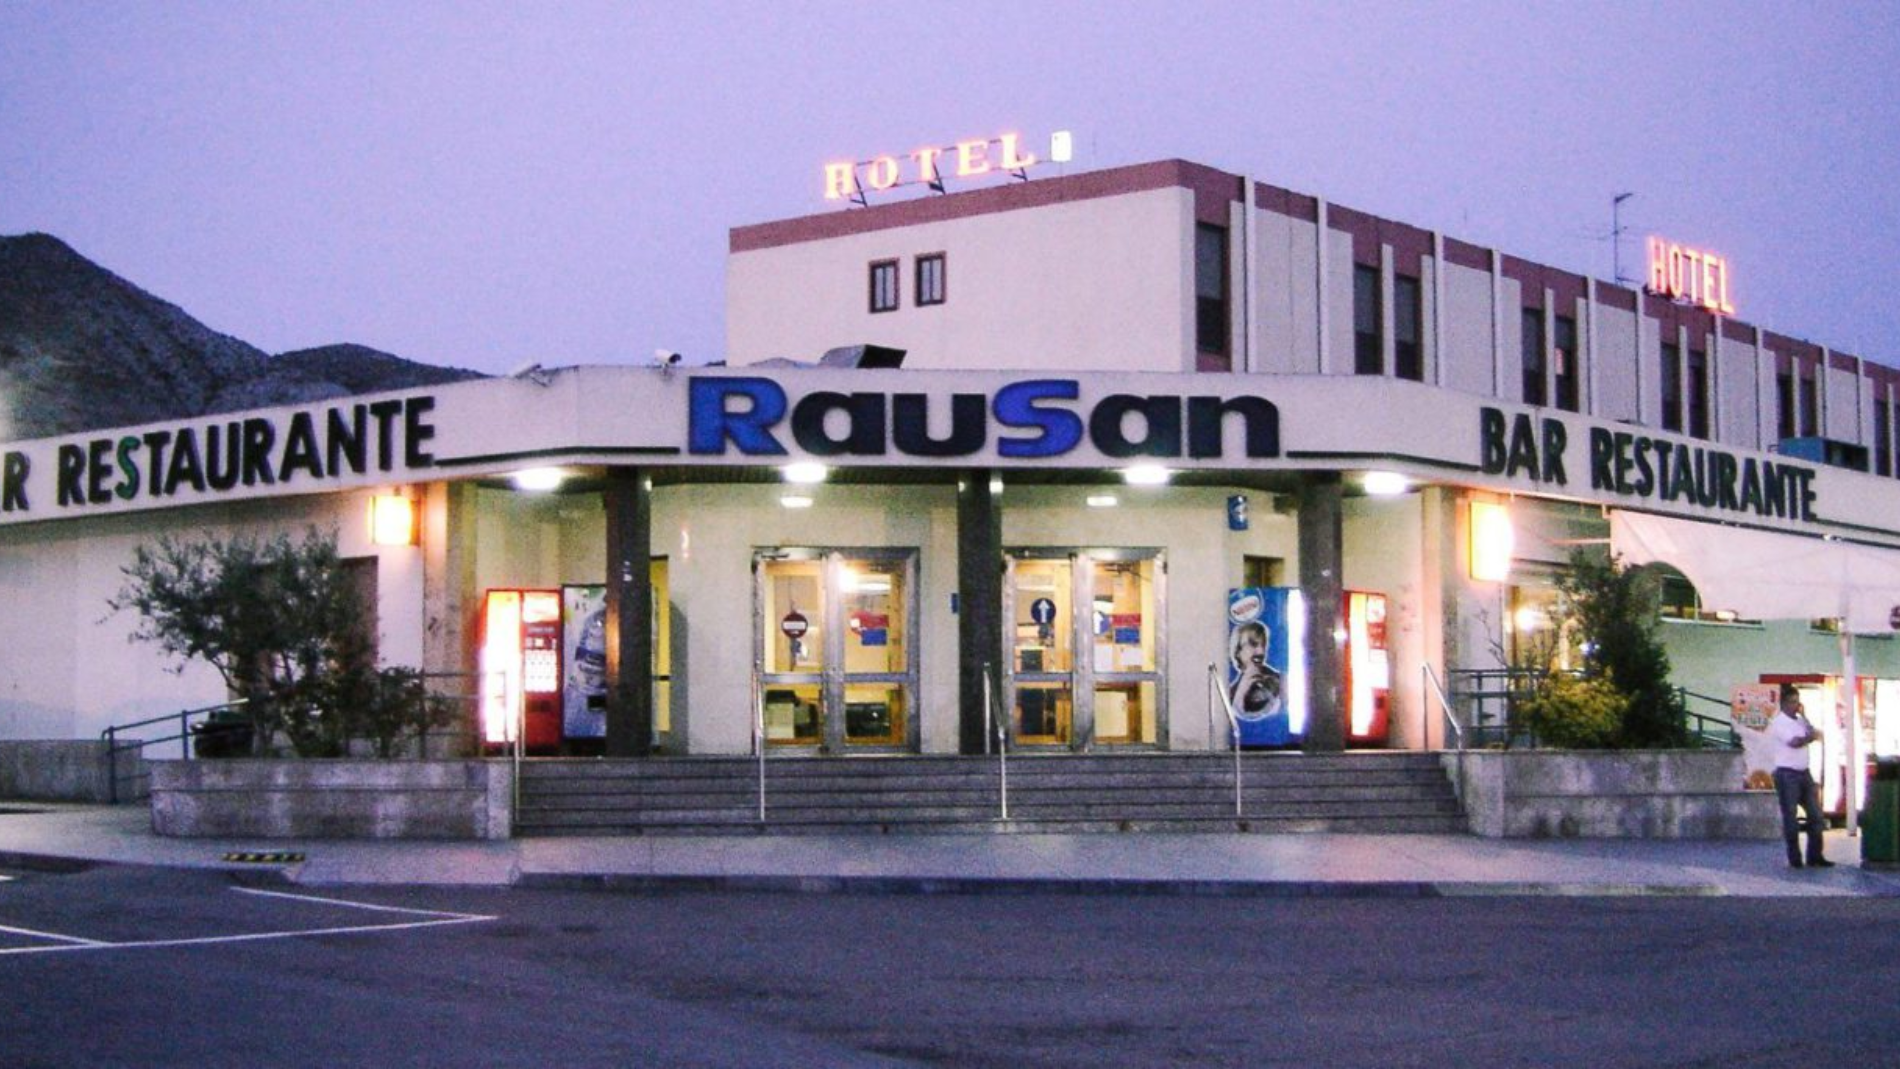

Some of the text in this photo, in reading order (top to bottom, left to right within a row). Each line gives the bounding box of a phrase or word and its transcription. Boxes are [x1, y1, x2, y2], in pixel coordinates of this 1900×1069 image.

[823, 132, 1037, 200] HOTEL
[1647, 236, 1735, 314] HOTEL
[57, 396, 436, 507] RESTAURANTE
[687, 376, 1281, 459] RauSan
[1479, 406, 1818, 523] BAR RESTAURANTE
